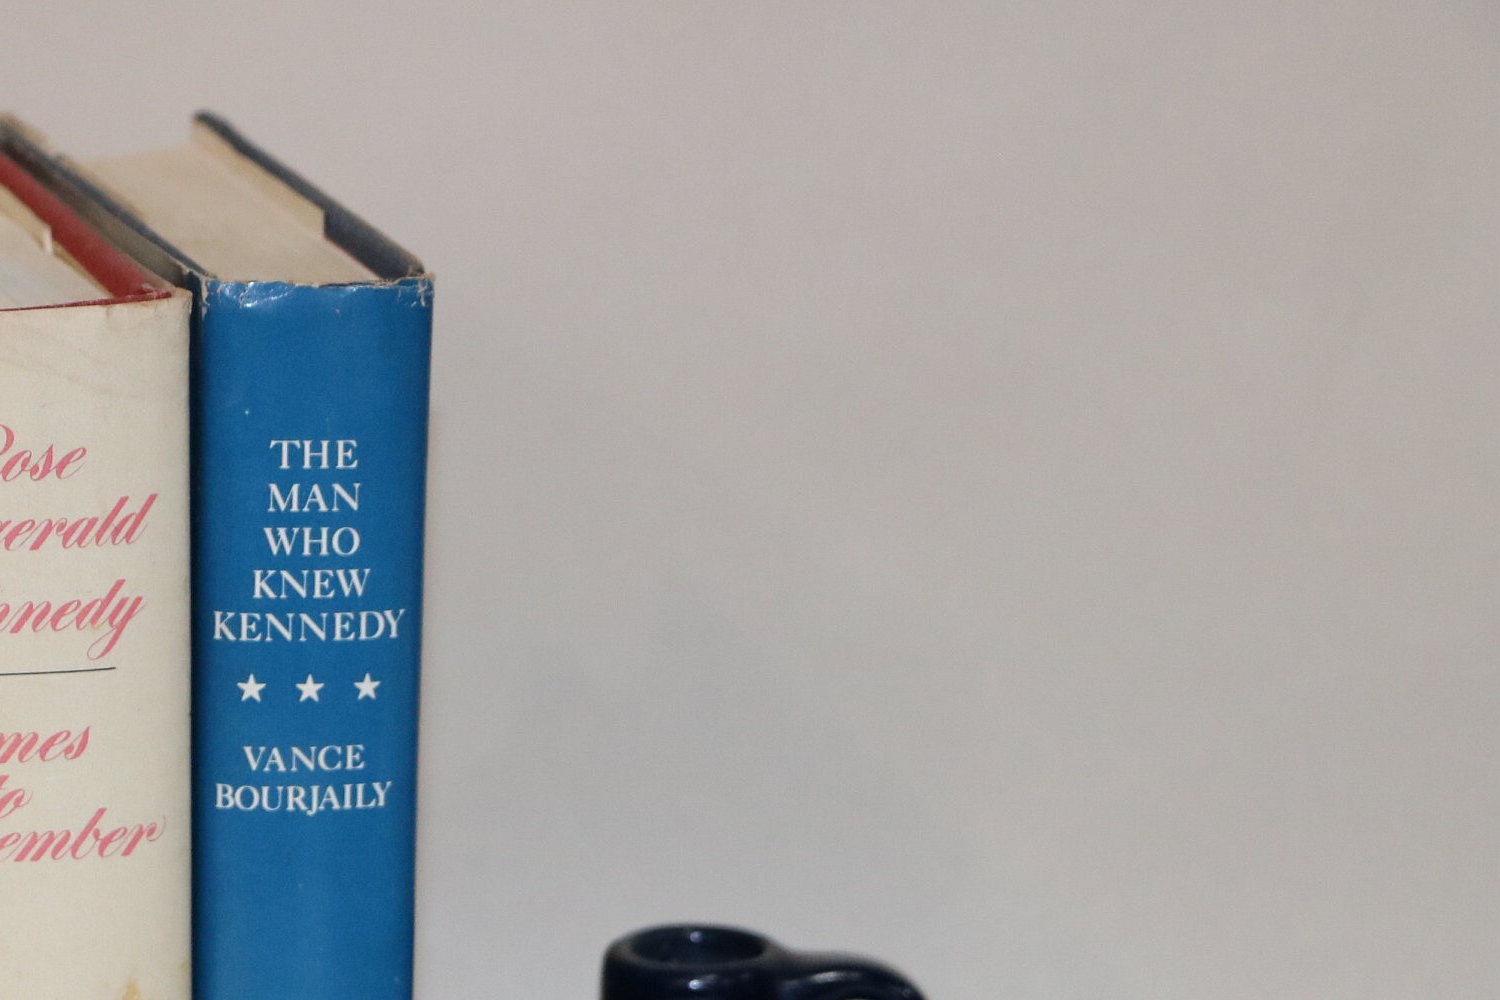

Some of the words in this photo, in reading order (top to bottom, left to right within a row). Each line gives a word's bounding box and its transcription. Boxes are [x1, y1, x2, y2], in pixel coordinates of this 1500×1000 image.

[269, 439, 359, 469] THE
[267, 483, 361, 512] MAN
[263, 526, 361, 556] WHO
[252, 568, 371, 599] KNEW
[213, 608, 406, 642] KENNEDY
[243, 744, 366, 772] VANCE
[214, 780, 392, 816] BOURJAILY
